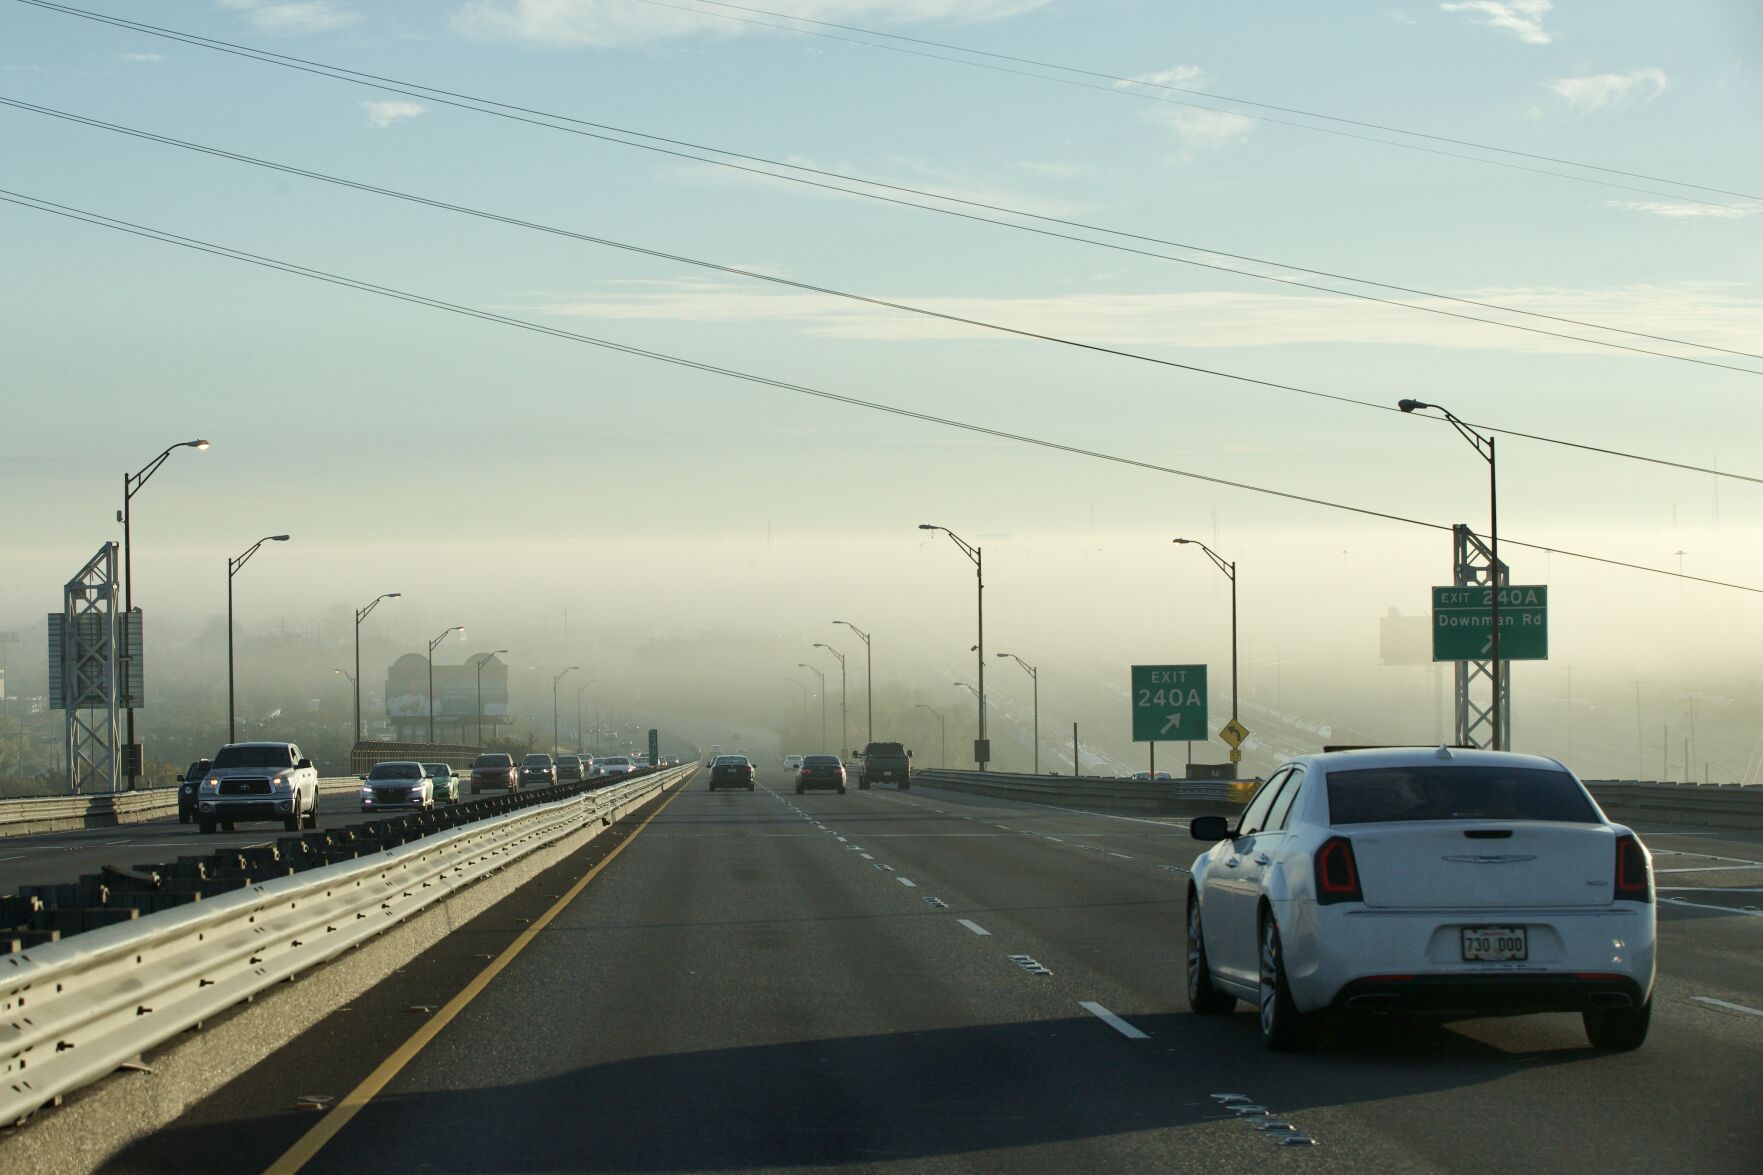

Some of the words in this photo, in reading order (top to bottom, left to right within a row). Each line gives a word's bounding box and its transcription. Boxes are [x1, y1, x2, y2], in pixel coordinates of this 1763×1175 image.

[1441, 593, 1471, 604] EXIT
[1482, 589, 1538, 605] 240A
[1439, 614, 1515, 627] Downman
[1522, 613, 1542, 626] Rd
[1151, 671, 1188, 684] EXIT
[1138, 688, 1201, 707] 240A
[1465, 936, 1490, 952] 730
